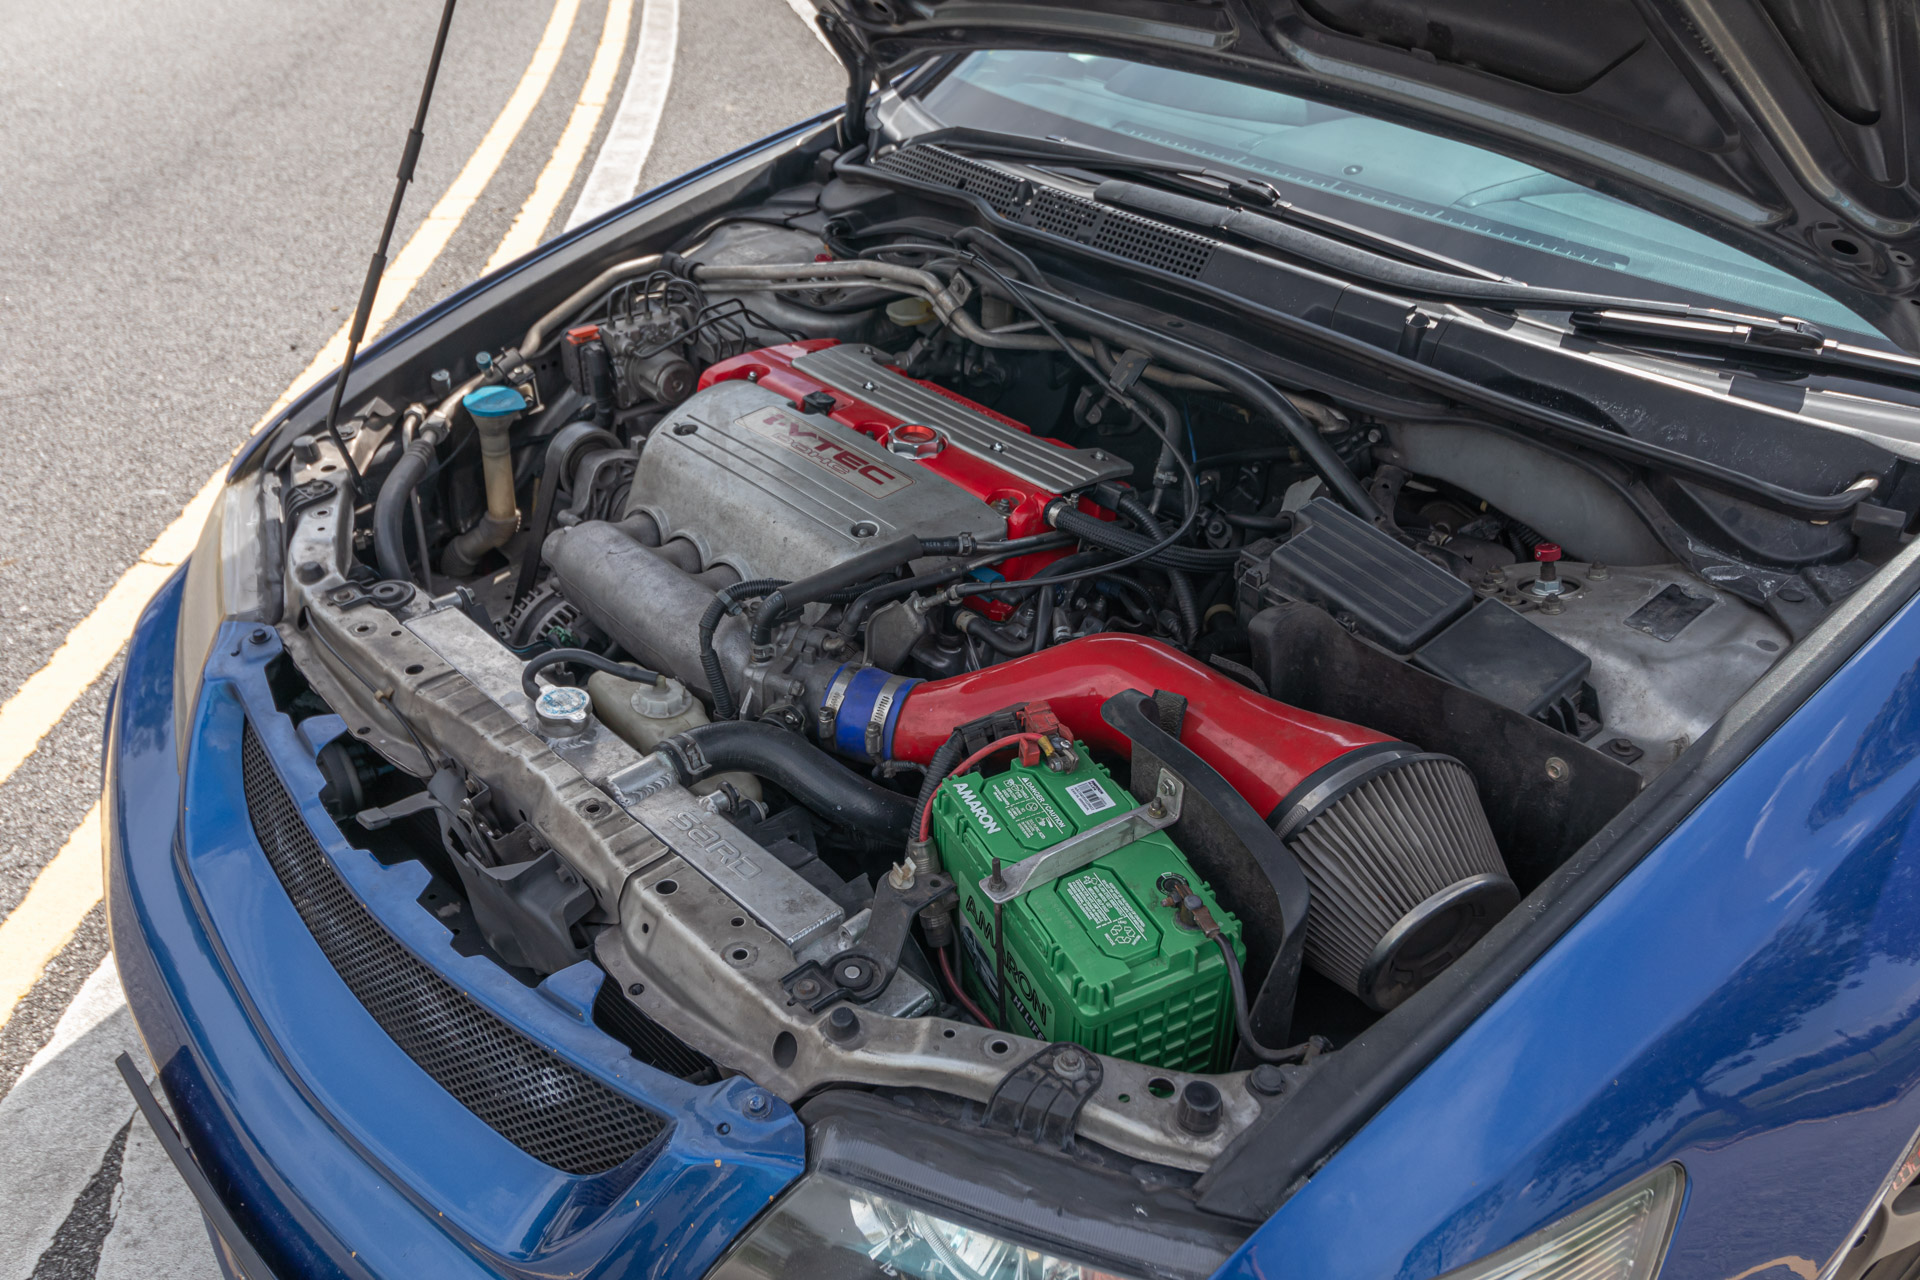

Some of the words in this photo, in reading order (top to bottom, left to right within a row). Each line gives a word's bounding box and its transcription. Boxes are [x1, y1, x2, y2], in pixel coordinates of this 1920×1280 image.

[771, 432, 850, 475] DOHC
[952, 782, 1002, 835] AMARON
[1027, 780, 1046, 803] DANGER
[1045, 805, 1067, 829] CAUTION
[1013, 995, 1025, 1011] HI
[1024, 1013, 1046, 1042] LIFE
